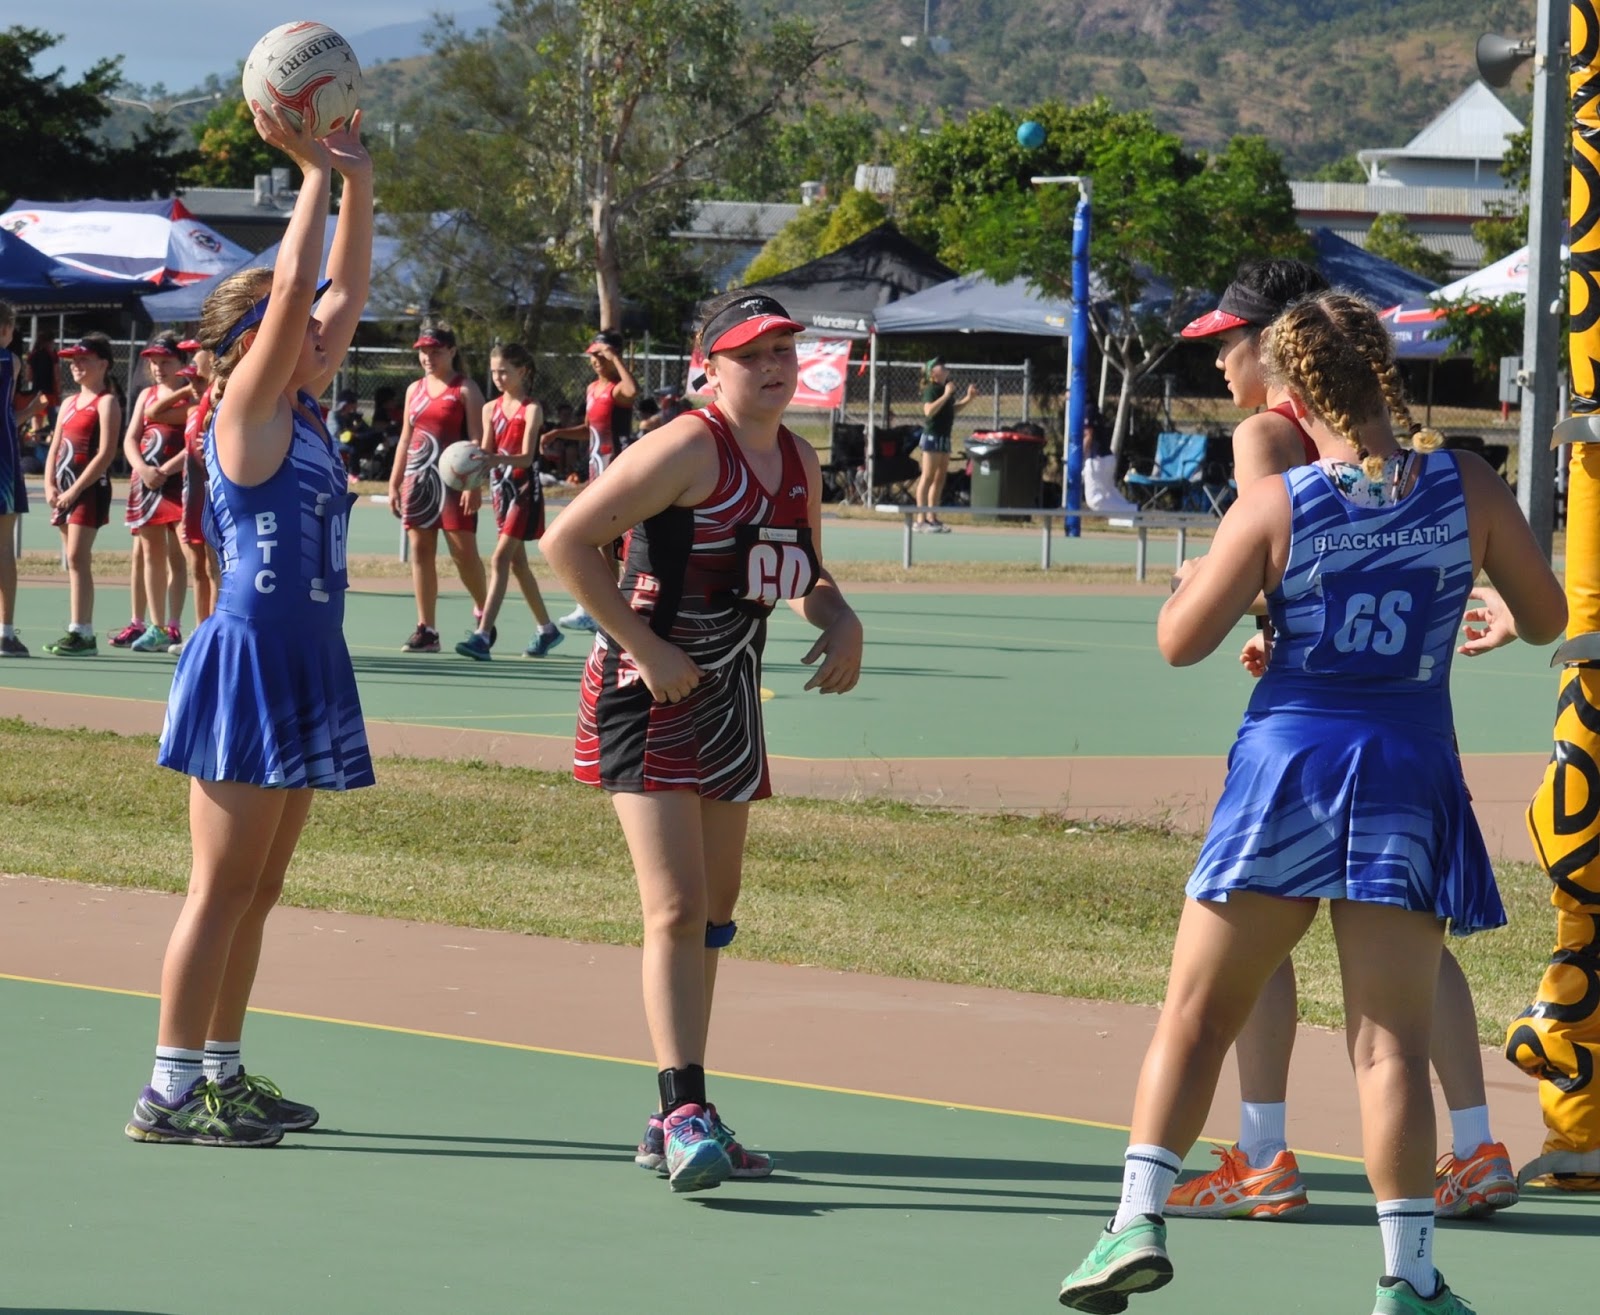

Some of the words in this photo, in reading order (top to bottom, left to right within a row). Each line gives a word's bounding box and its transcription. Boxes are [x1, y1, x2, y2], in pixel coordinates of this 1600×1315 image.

[277, 35, 345, 80] GILBERT
[254, 511, 278, 594] BTC
[331, 511, 347, 573] G
[1313, 524, 1450, 554] BLACKHEATH
[743, 543, 812, 607] GD
[1334, 590, 1413, 656] GS
[1416, 1226, 1428, 1258] BTC
